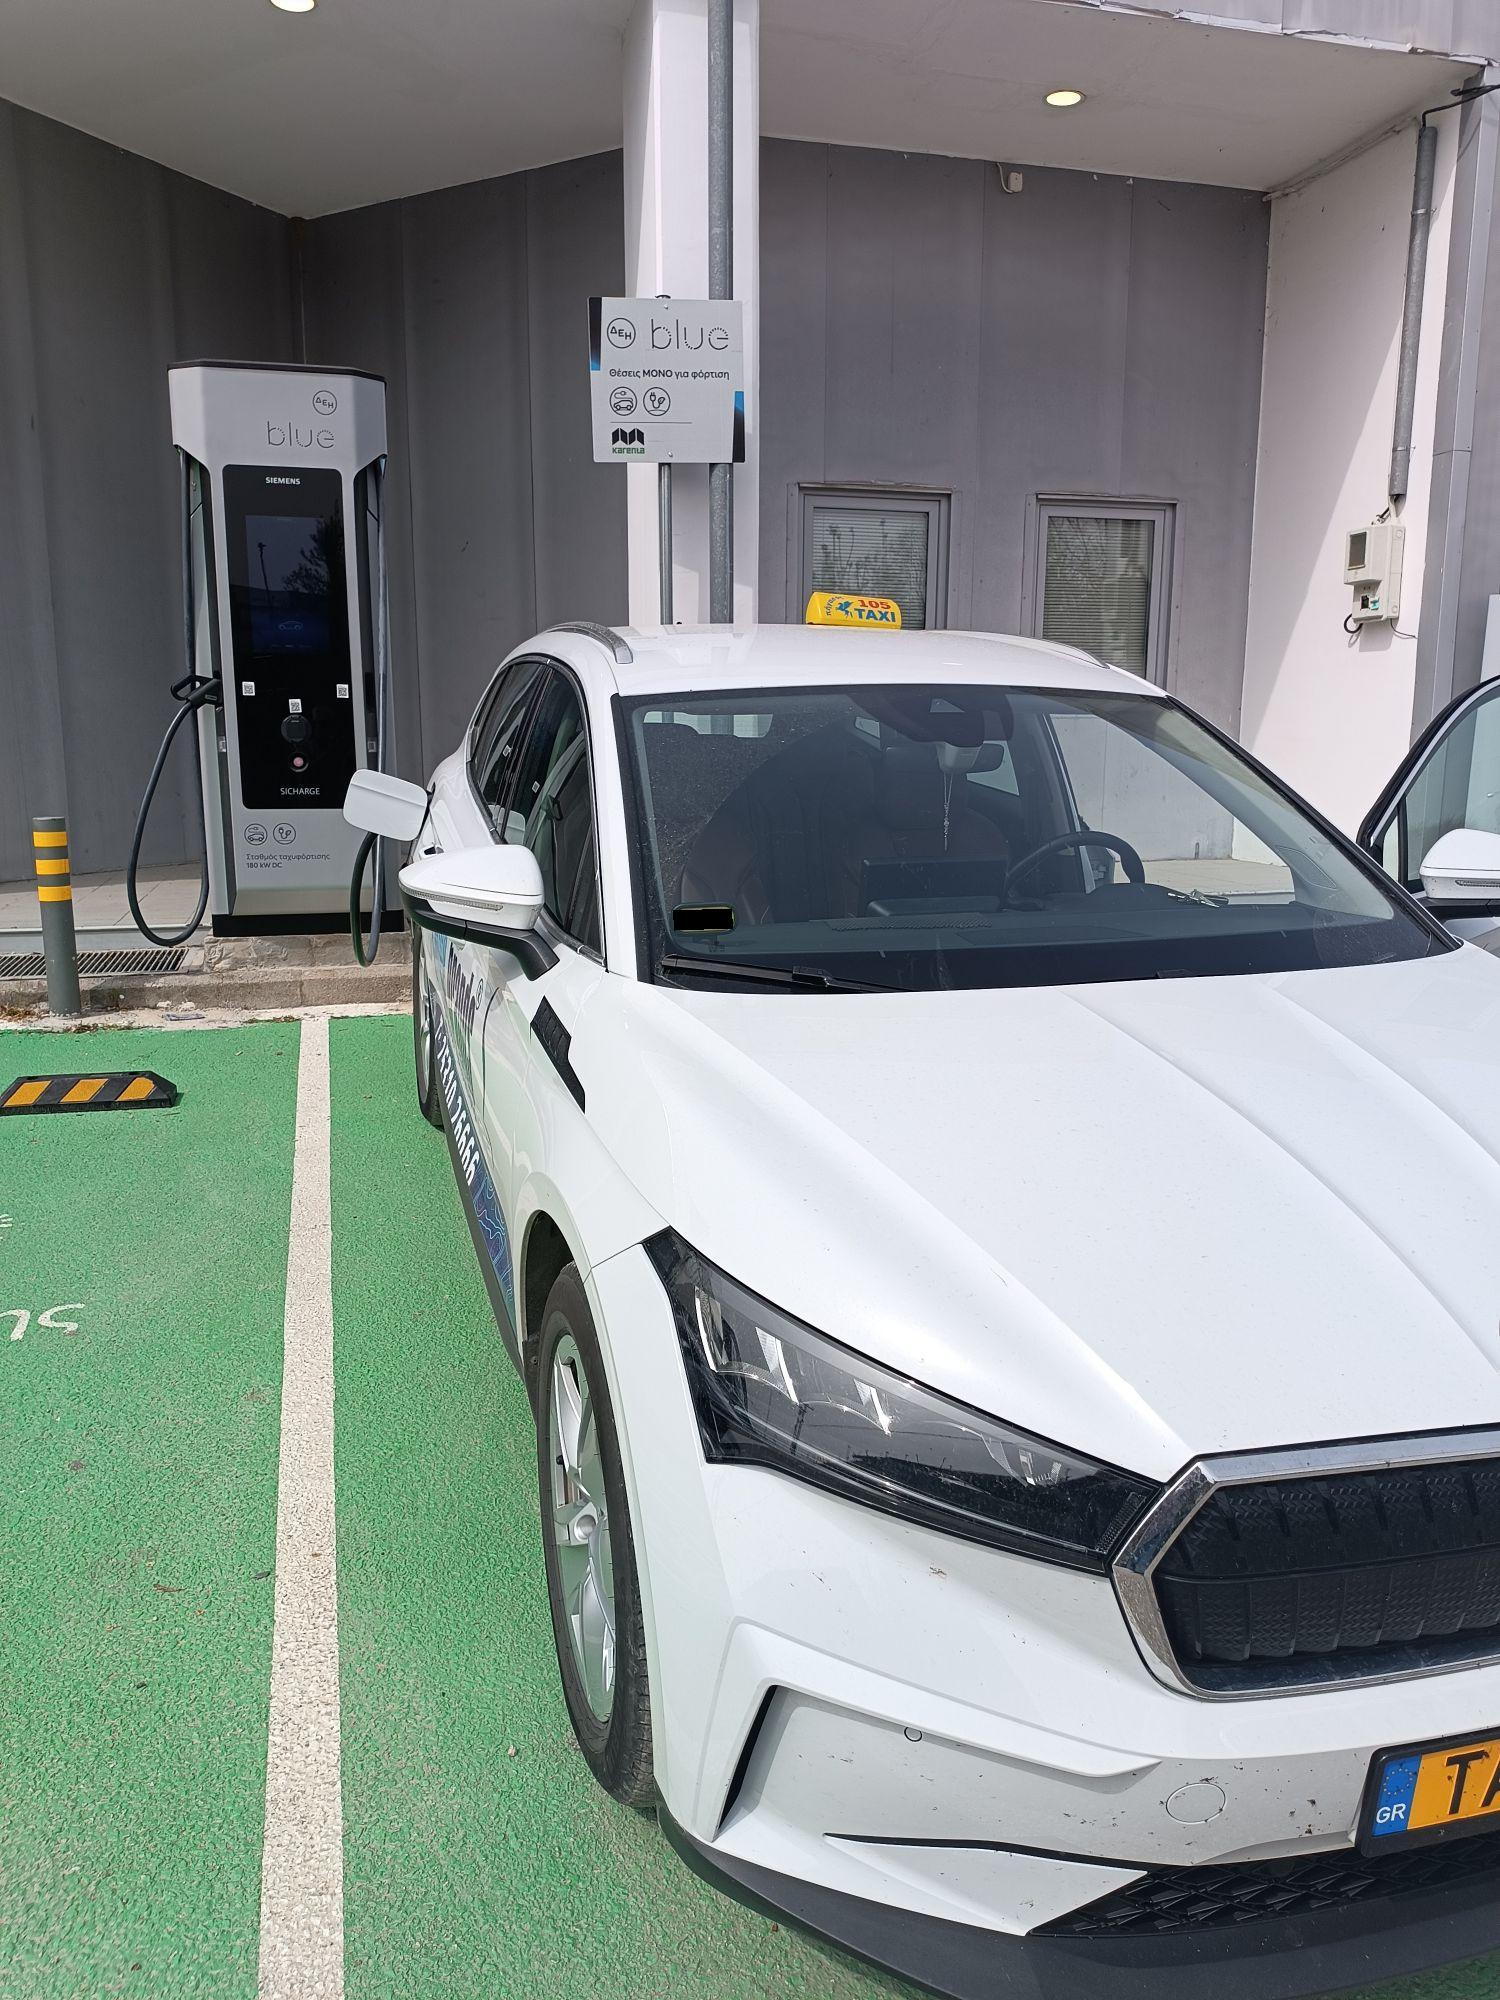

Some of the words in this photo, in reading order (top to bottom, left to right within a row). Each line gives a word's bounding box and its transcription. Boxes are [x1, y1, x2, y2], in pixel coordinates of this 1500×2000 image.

[650, 318, 730, 351] blue
[609, 368, 642, 380] Θέσεις
[674, 370, 690, 381] για
[690, 368, 730, 381] φόρτιση
[267, 420, 335, 449] blue
[265, 476, 301, 485] SIEMENS
[858, 600, 891, 609] 105
[854, 608, 896, 623] TAXI
[280, 787, 321, 796] SICHARGE
[246, 853, 278, 861] Σταθμός
[279, 853, 331, 862] ταχυφόρτισης
[1375, 1802, 1406, 1824] GR
